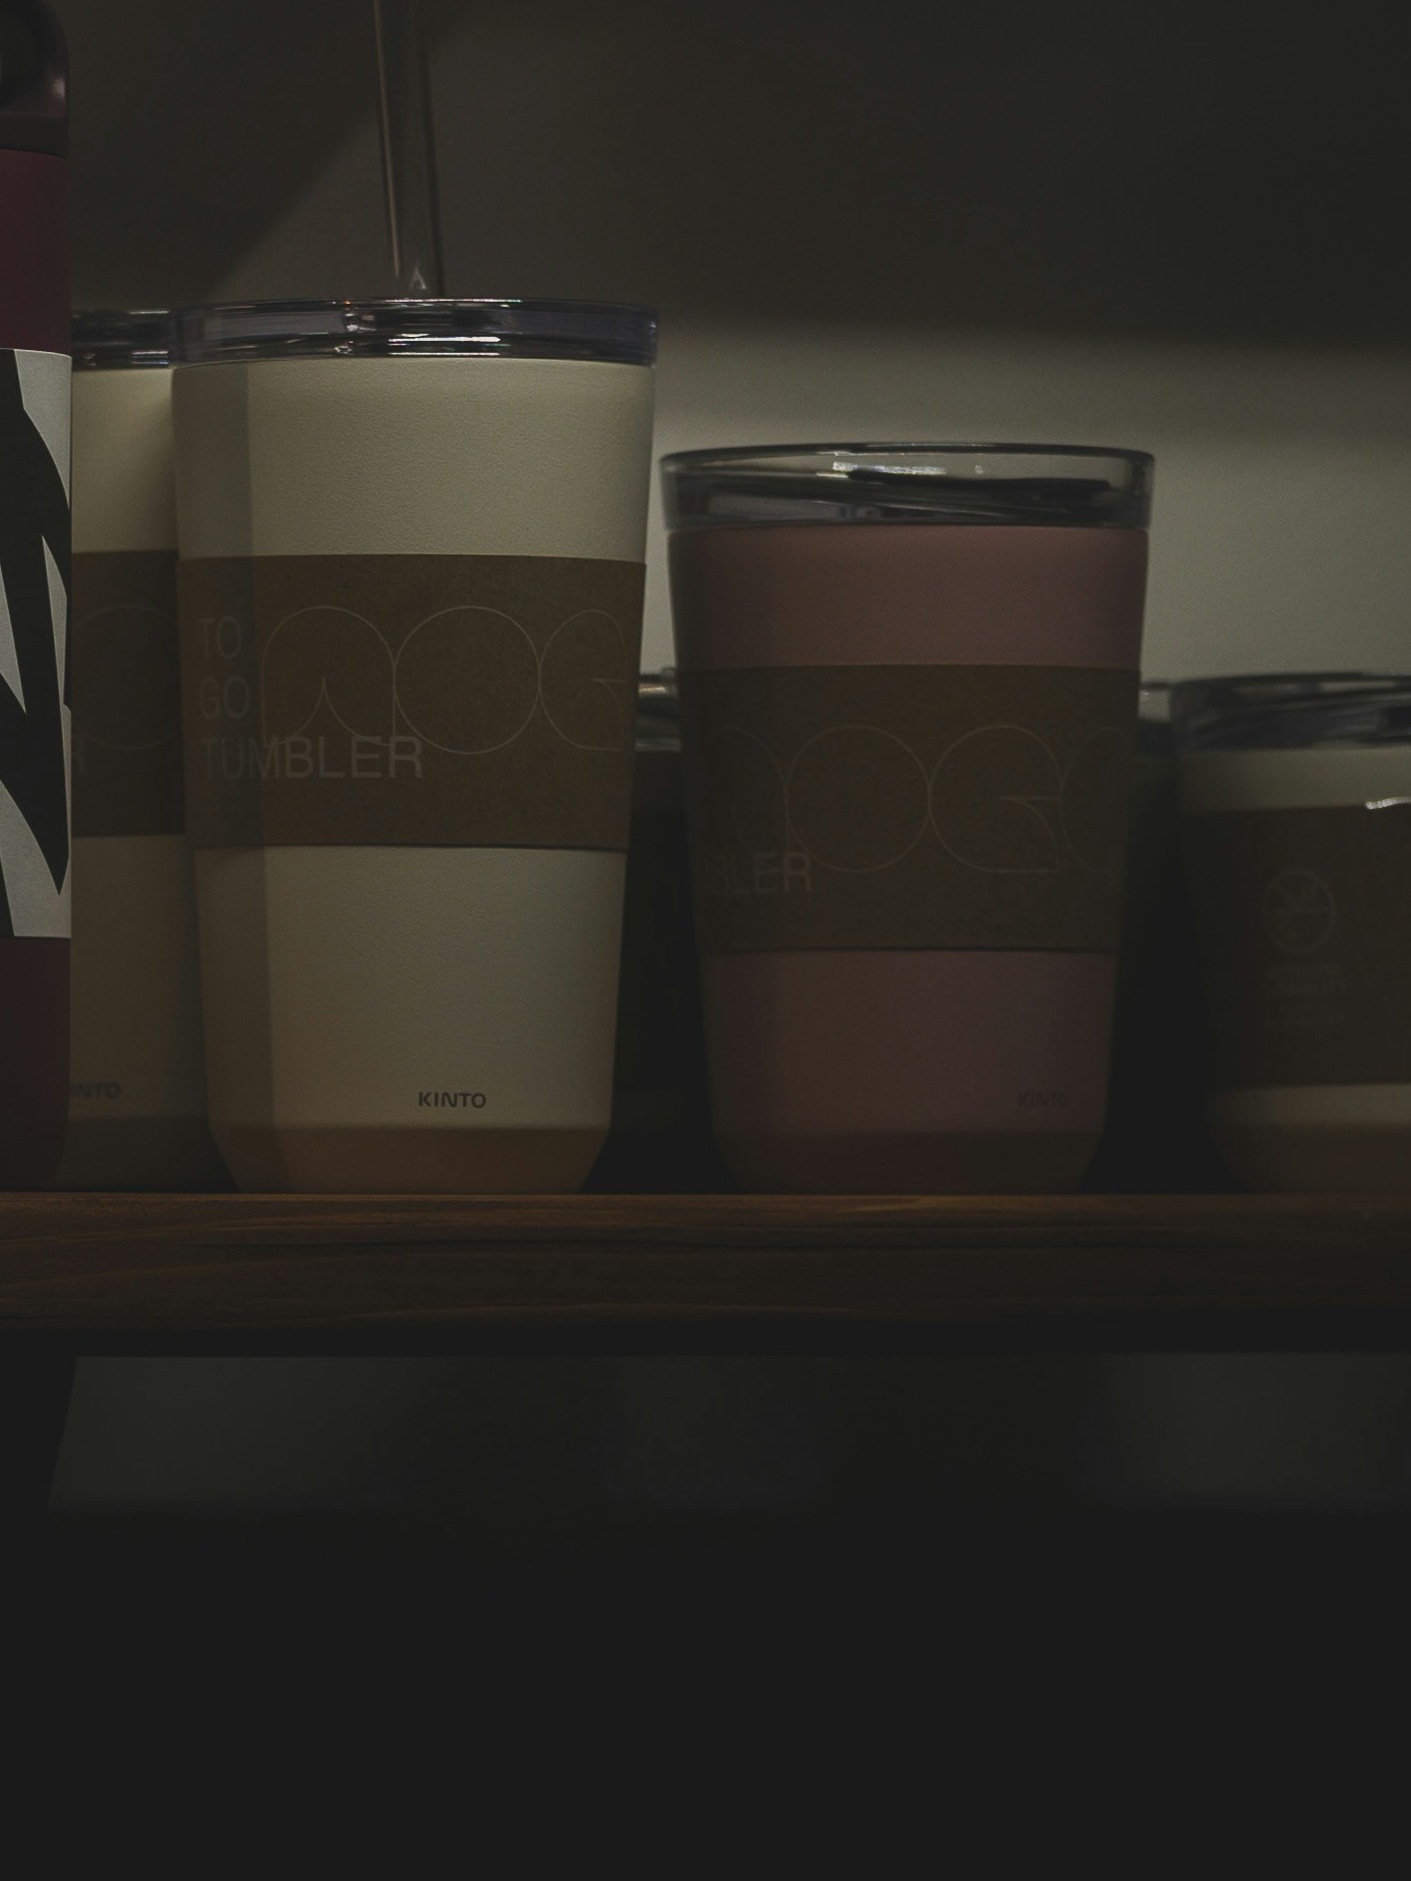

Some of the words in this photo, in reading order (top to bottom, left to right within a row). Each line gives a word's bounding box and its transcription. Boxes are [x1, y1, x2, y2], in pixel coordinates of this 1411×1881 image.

[197, 617, 243, 660] TO
[199, 678, 250, 720] GO
[200, 736, 424, 779] TUMBLER
[418, 1092, 486, 1108] KINTO
